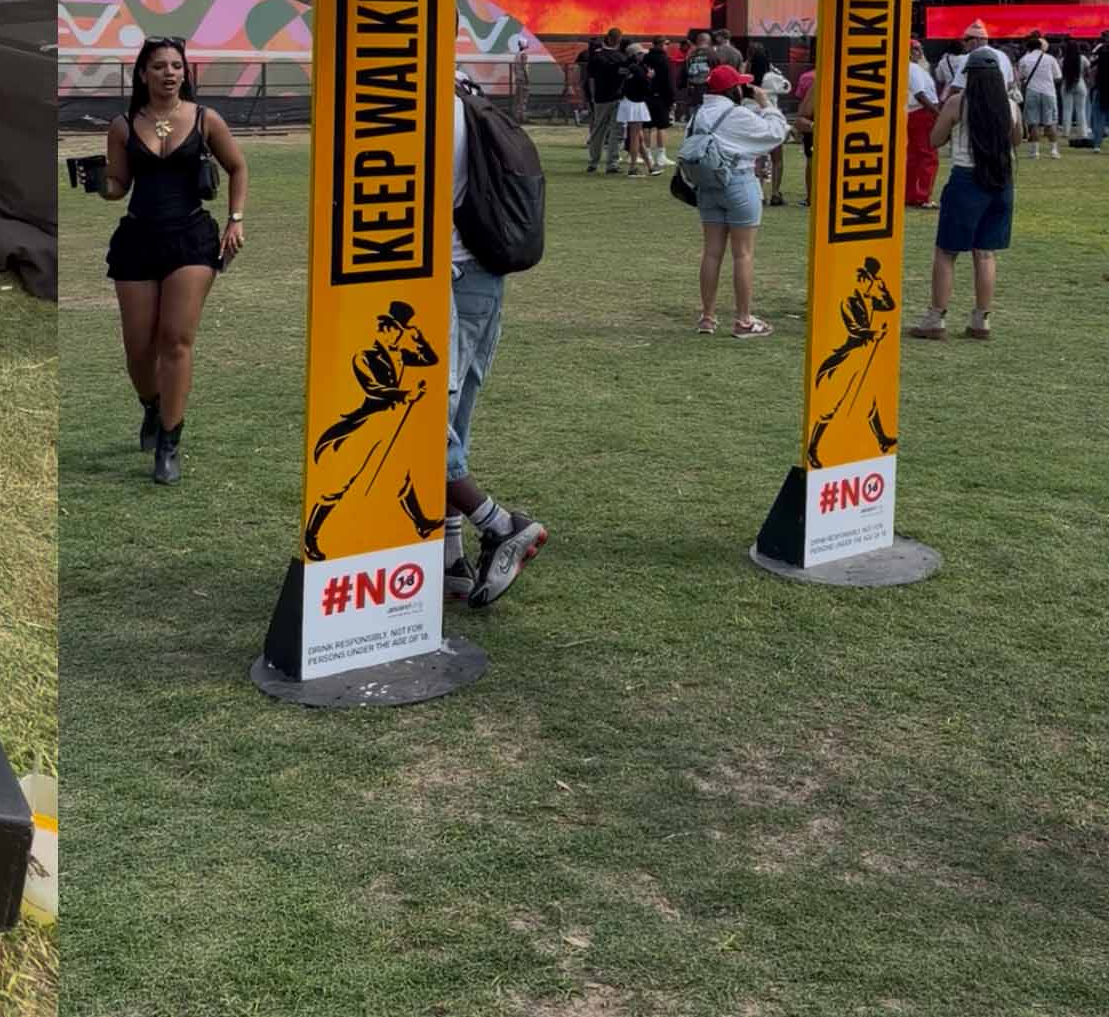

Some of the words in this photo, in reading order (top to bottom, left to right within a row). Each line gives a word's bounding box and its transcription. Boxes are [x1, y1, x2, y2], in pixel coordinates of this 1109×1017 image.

[352, 151, 416, 265] KEEP
[842, 131, 884, 226] KEEP
[308, 643, 334, 656] DRINK
[390, 626, 406, 637] NOT
[407, 624, 424, 634] FOR
[308, 652, 347, 665] PERSONS
[347, 645, 374, 657] UNDER
